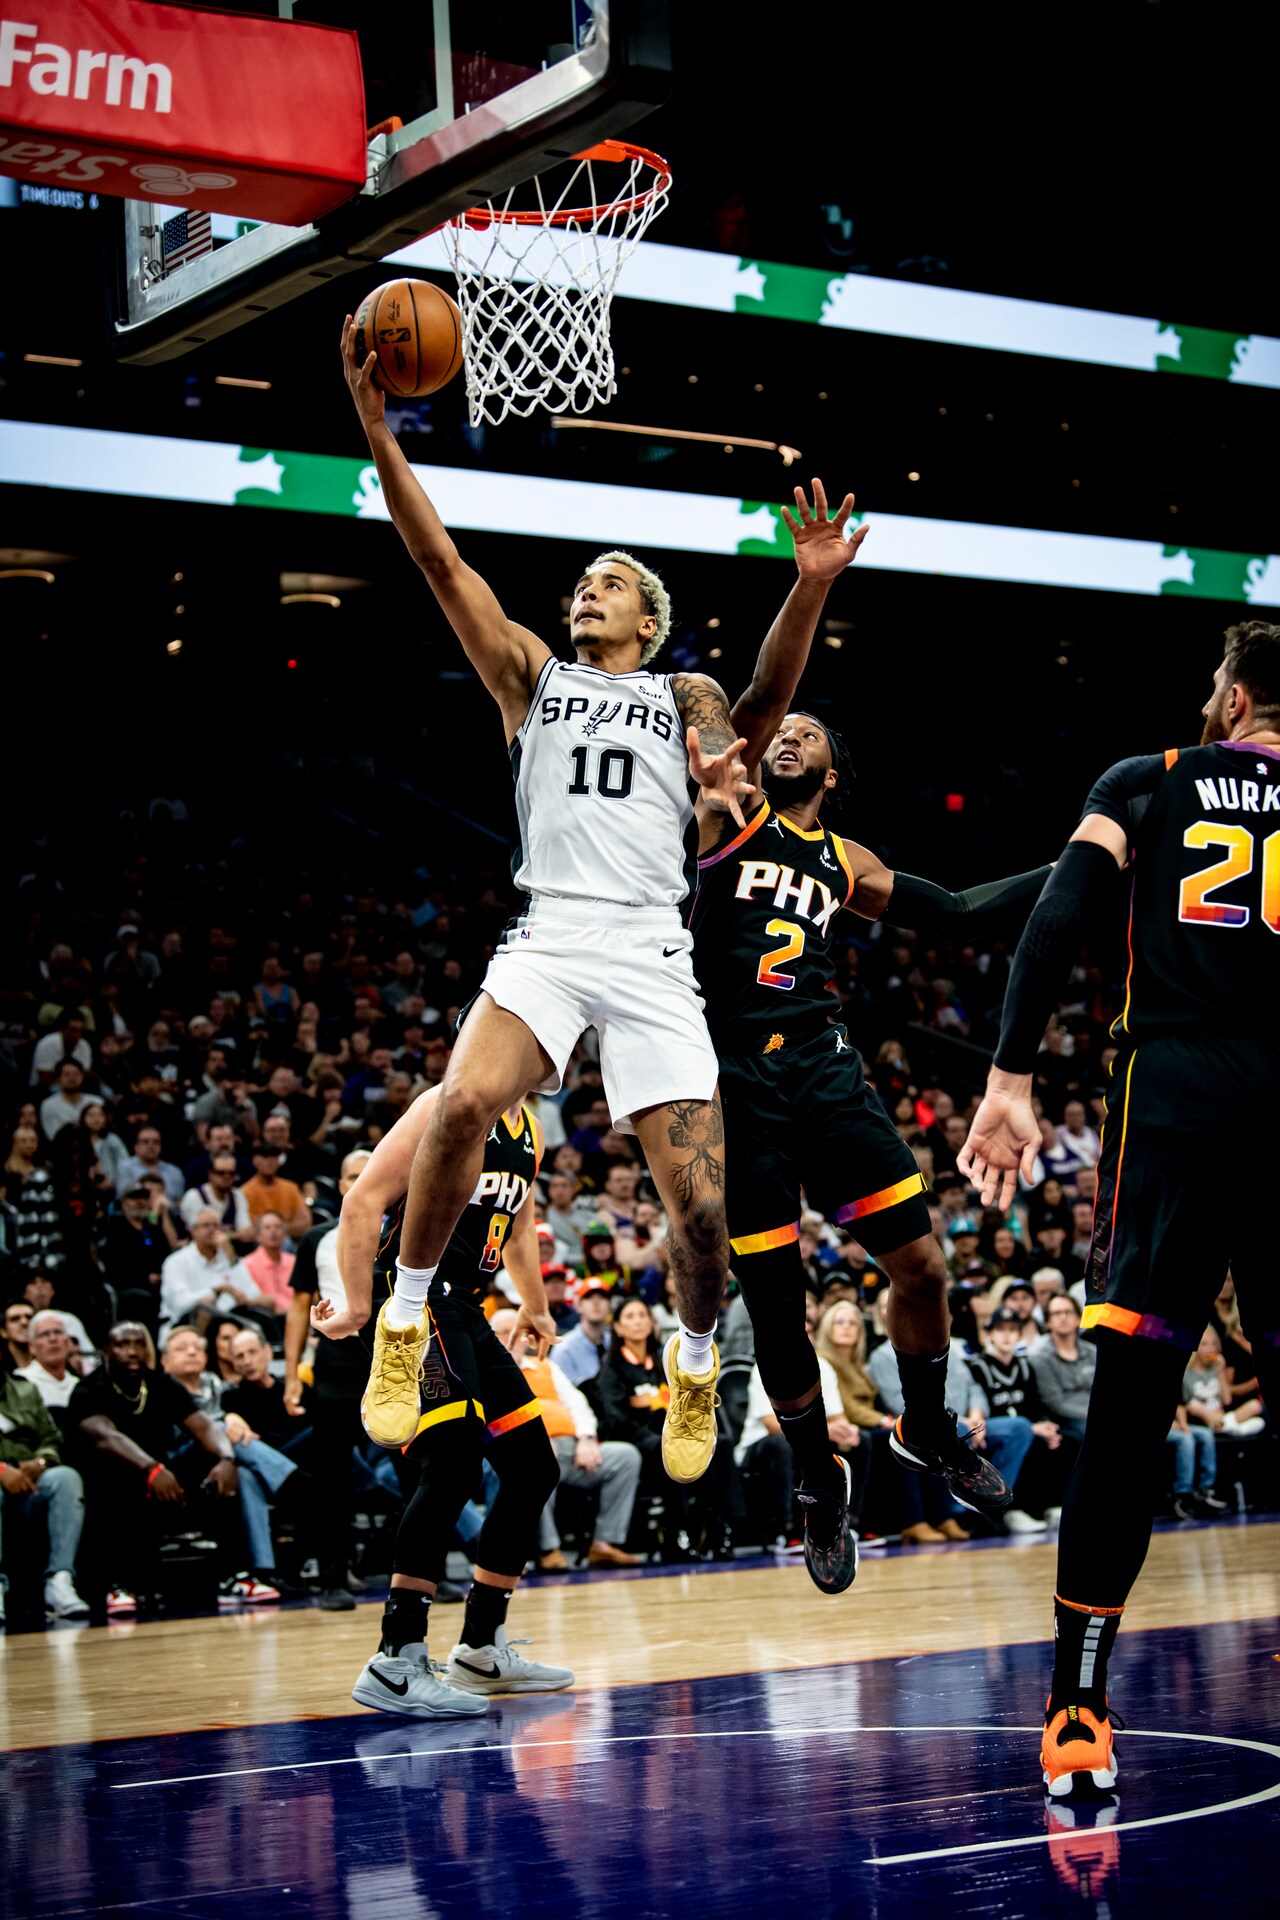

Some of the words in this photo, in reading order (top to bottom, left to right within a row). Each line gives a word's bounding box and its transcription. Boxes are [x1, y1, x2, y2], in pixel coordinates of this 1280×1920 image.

[0, 20, 172, 113] Farm
[0, 137, 129, 181] Sta
[541, 697, 673, 742] SPURS
[566, 744, 636, 799] 10
[735, 860, 841, 939] PHX
[756, 918, 805, 990] 2
[478, 1213, 510, 1272] 8
